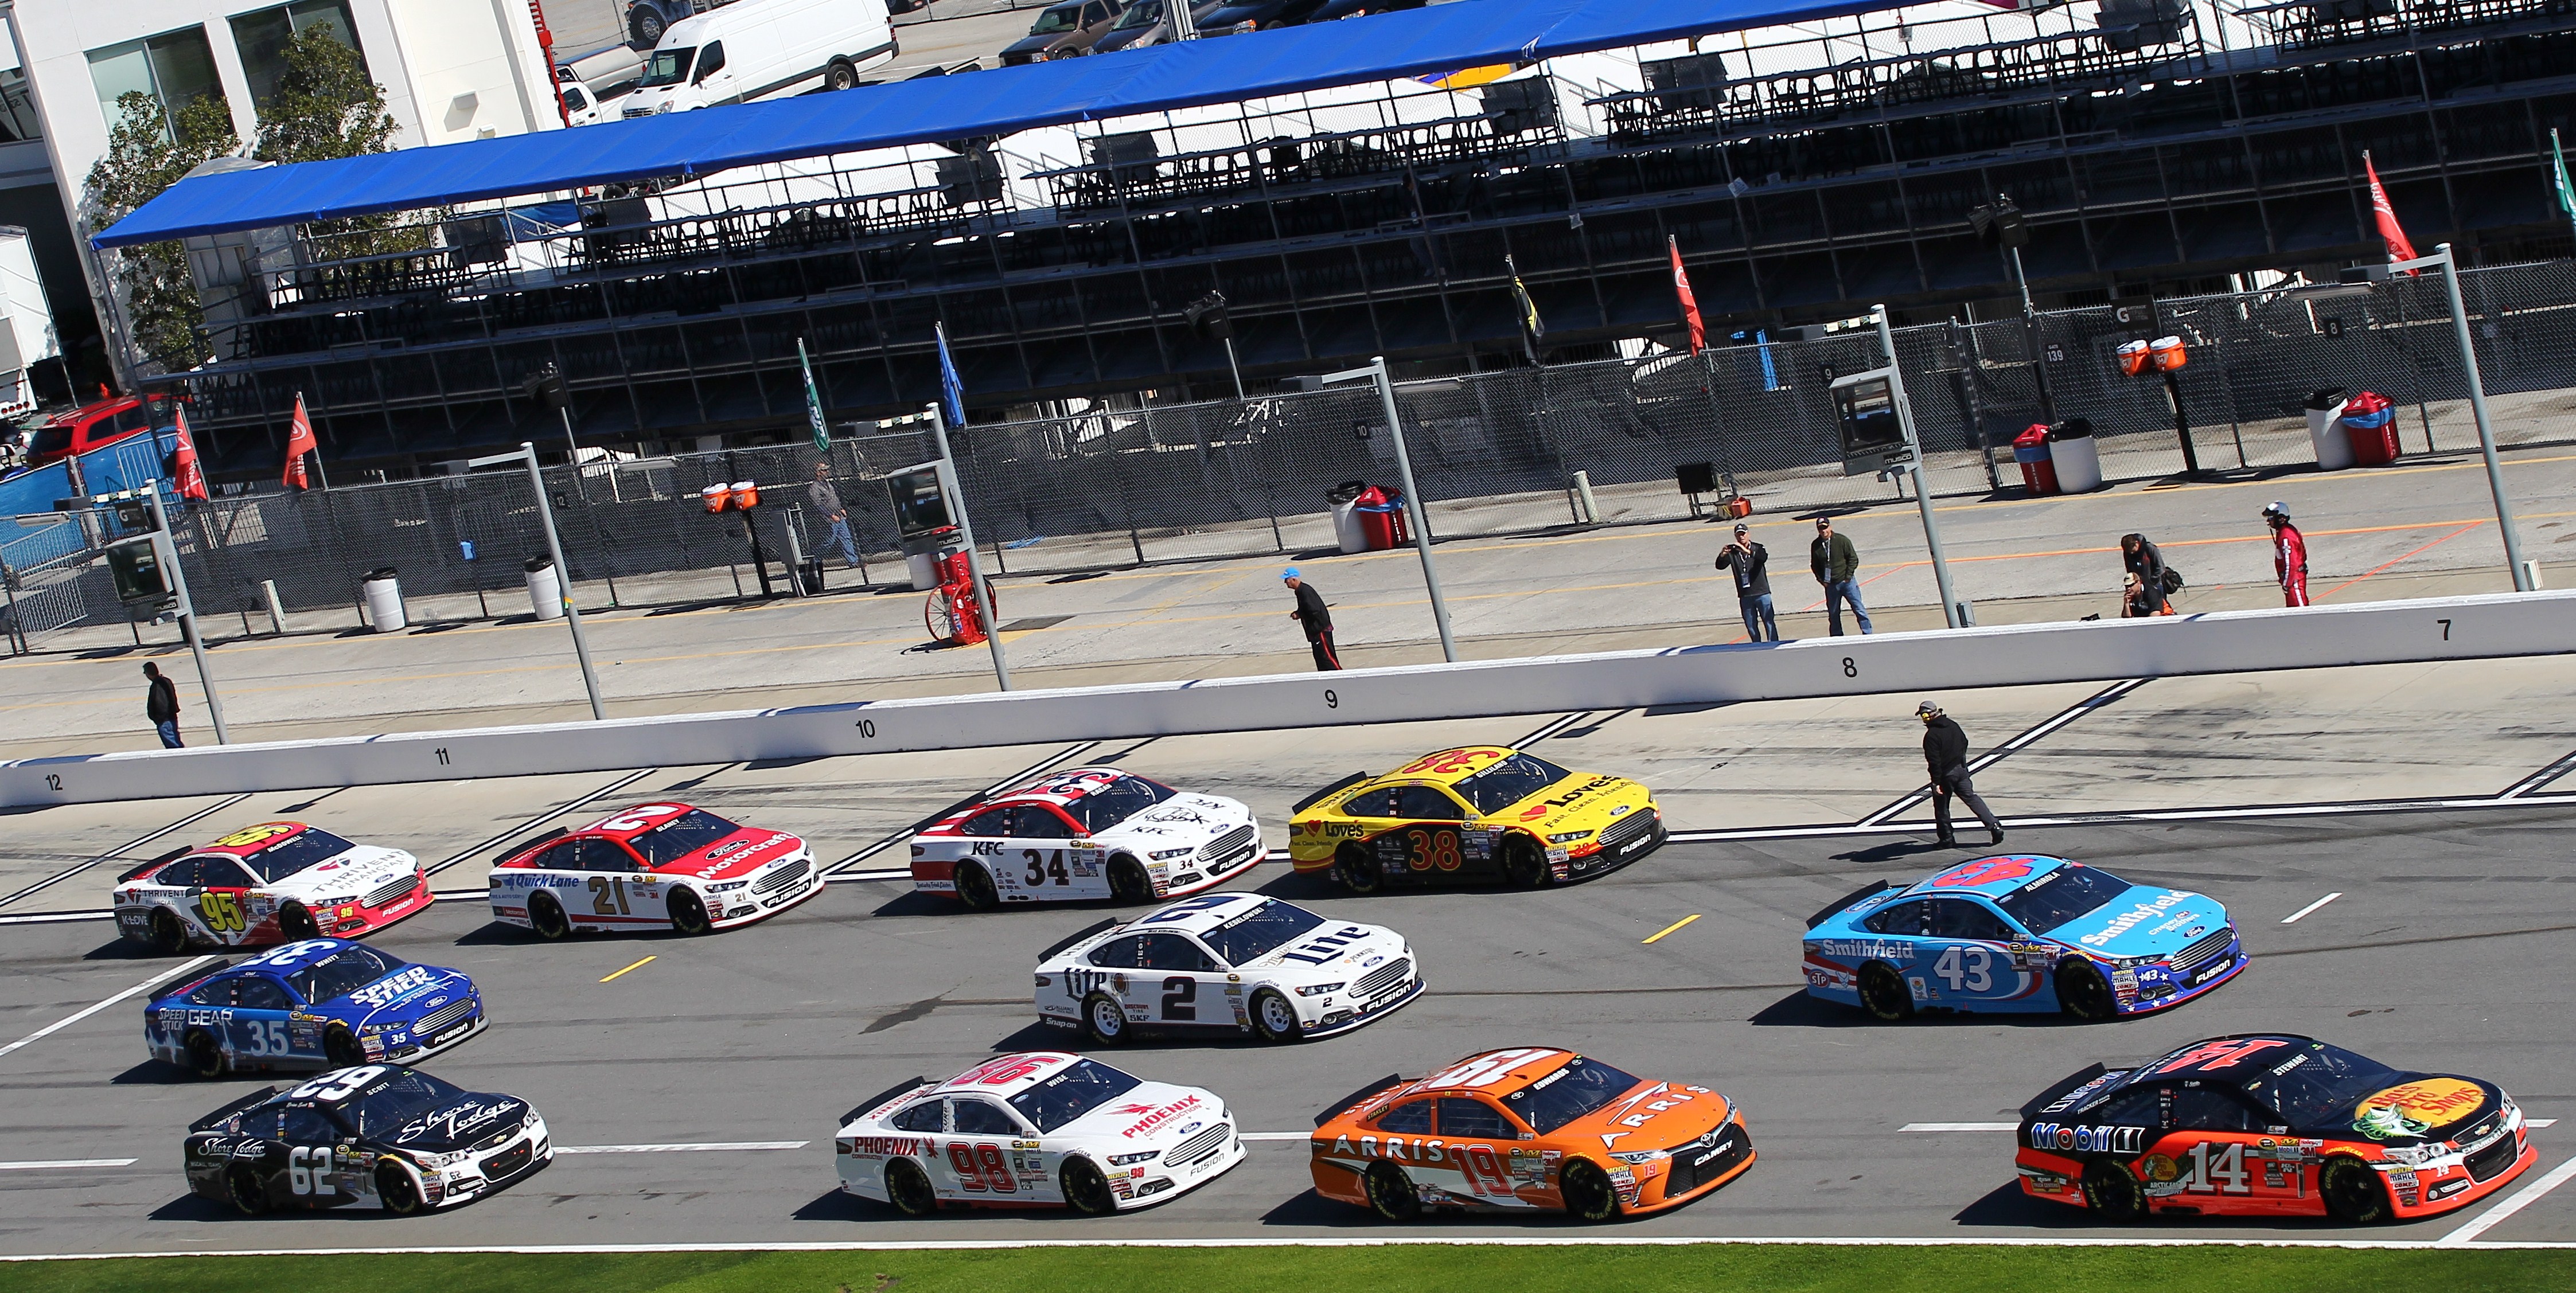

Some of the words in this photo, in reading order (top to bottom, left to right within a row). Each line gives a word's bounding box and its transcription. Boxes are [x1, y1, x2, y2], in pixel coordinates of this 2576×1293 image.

[2330, 323, 2337, 334] 8
[2047, 349, 2064, 362] 139
[1825, 368, 1832, 380] 9
[1357, 425, 1367, 436] 10
[1885, 454, 1912, 464] musco
[937, 536, 962, 546] musco
[154, 602, 177, 611] musco
[2438, 619, 2452, 641] 7
[1843, 657, 1857, 678] 8
[1325, 689, 1338, 709] 9
[856, 719, 875, 739] 10
[435, 748, 450, 765] 11
[1476, 760, 1508, 778] GILLILAND
[45, 774, 63, 791] 12
[1090, 783, 1112, 797] RAGAN
[656, 818, 680, 833] BLANEY
[1323, 820, 1364, 838] Love's
[267, 835, 303, 853] McDOWELL
[971, 841, 1004, 856] KFC
[1408, 830, 1461, 871] 38
[1620, 833, 1651, 856] FUSION
[696, 831, 797, 880] Motorcraft
[1179, 858, 1194, 870] 34
[1219, 850, 1250, 872] FUSION
[311, 850, 406, 893] THRIVENT
[338, 858, 404, 890] FINANCIAL
[1022, 849, 1070, 886] 34
[2024, 871, 2061, 893] ALMIROLA
[143, 889, 185, 897] THRIVENT
[588, 877, 630, 915] 21
[735, 893, 746, 903] 21
[767, 879, 810, 908] FUSION
[200, 892, 247, 931] 95
[340, 907, 353, 919] 95
[382, 898, 414, 917] FUSION
[1223, 907, 1264, 929] KESELOWSKI
[2080, 889, 2196, 947] Smithfield
[1284, 926, 1370, 967] Lite
[1822, 938, 1916, 960] Smithfield
[315, 954, 340, 968] WHITT
[1932, 946, 1992, 992] 43
[1811, 973, 1827, 985] STP
[2113, 975, 2137, 984] MAHLE
[2142, 970, 2158, 981] 43
[2196, 959, 2231, 985] FUSION
[350, 966, 426, 1005] SPEED
[367, 972, 437, 1009] STICK
[1162, 976, 1197, 1021] 2
[1322, 997, 1332, 1007] 2
[1366, 984, 1411, 1013] FUSION
[158, 1007, 186, 1020] SPEED
[188, 1009, 235, 1026] GEAR
[1046, 1017, 1077, 1029] Snap-on
[161, 1020, 183, 1032] STICK
[434, 1022, 469, 1044] FUSION
[247, 1021, 289, 1057] 35
[391, 1032, 407, 1045] 35
[2272, 1054, 2309, 1076] STEWART
[367, 1082, 390, 1096] SCOTT
[1046, 1074, 1069, 1088] WISE
[1533, 1068, 1570, 1091] EDWARDS
[2370, 1085, 2423, 1108] Bass
[2400, 1091, 2438, 1110] Pro
[2418, 1088, 2482, 1116] Shops
[396, 1100, 480, 1143] Shore
[446, 1100, 520, 1140] Lodge
[1122, 1094, 1202, 1139] PHOENIX
[1144, 1104, 1202, 1137] CONSTRUCTION
[1367, 1104, 1389, 1120] STANLEY
[1600, 1085, 1710, 1151] ARRIS
[854, 1137, 921, 1156] PHOENIX
[2031, 1122, 2114, 1153] Mobil
[197, 1138, 232, 1156] Shore
[232, 1138, 266, 1161] Lodge
[1333, 1134, 1444, 1162] ARRIS
[1694, 1139, 1733, 1167] CAMRY
[2301, 1147, 2315, 1157] 3M
[289, 1146, 336, 1194] 62
[946, 1142, 1018, 1194] 98
[1131, 1166, 1145, 1179] 98
[1190, 1152, 1225, 1177] FUSION
[1448, 1144, 1516, 1197] 19
[1543, 1159, 1556, 1167] 3M
[1605, 1165, 1629, 1174] MOOG
[1643, 1163, 1658, 1177] 19
[2187, 1141, 2253, 1197] 14
[2387, 1166, 2414, 1175] MOOG
[2435, 1163, 2450, 1178] 14
[450, 1171, 462, 1179] 62
[1609, 1171, 1632, 1179] MAHLE
[2324, 1158, 2361, 1190] GOODYEAR
[2390, 1173, 2417, 1182] MAHLE
